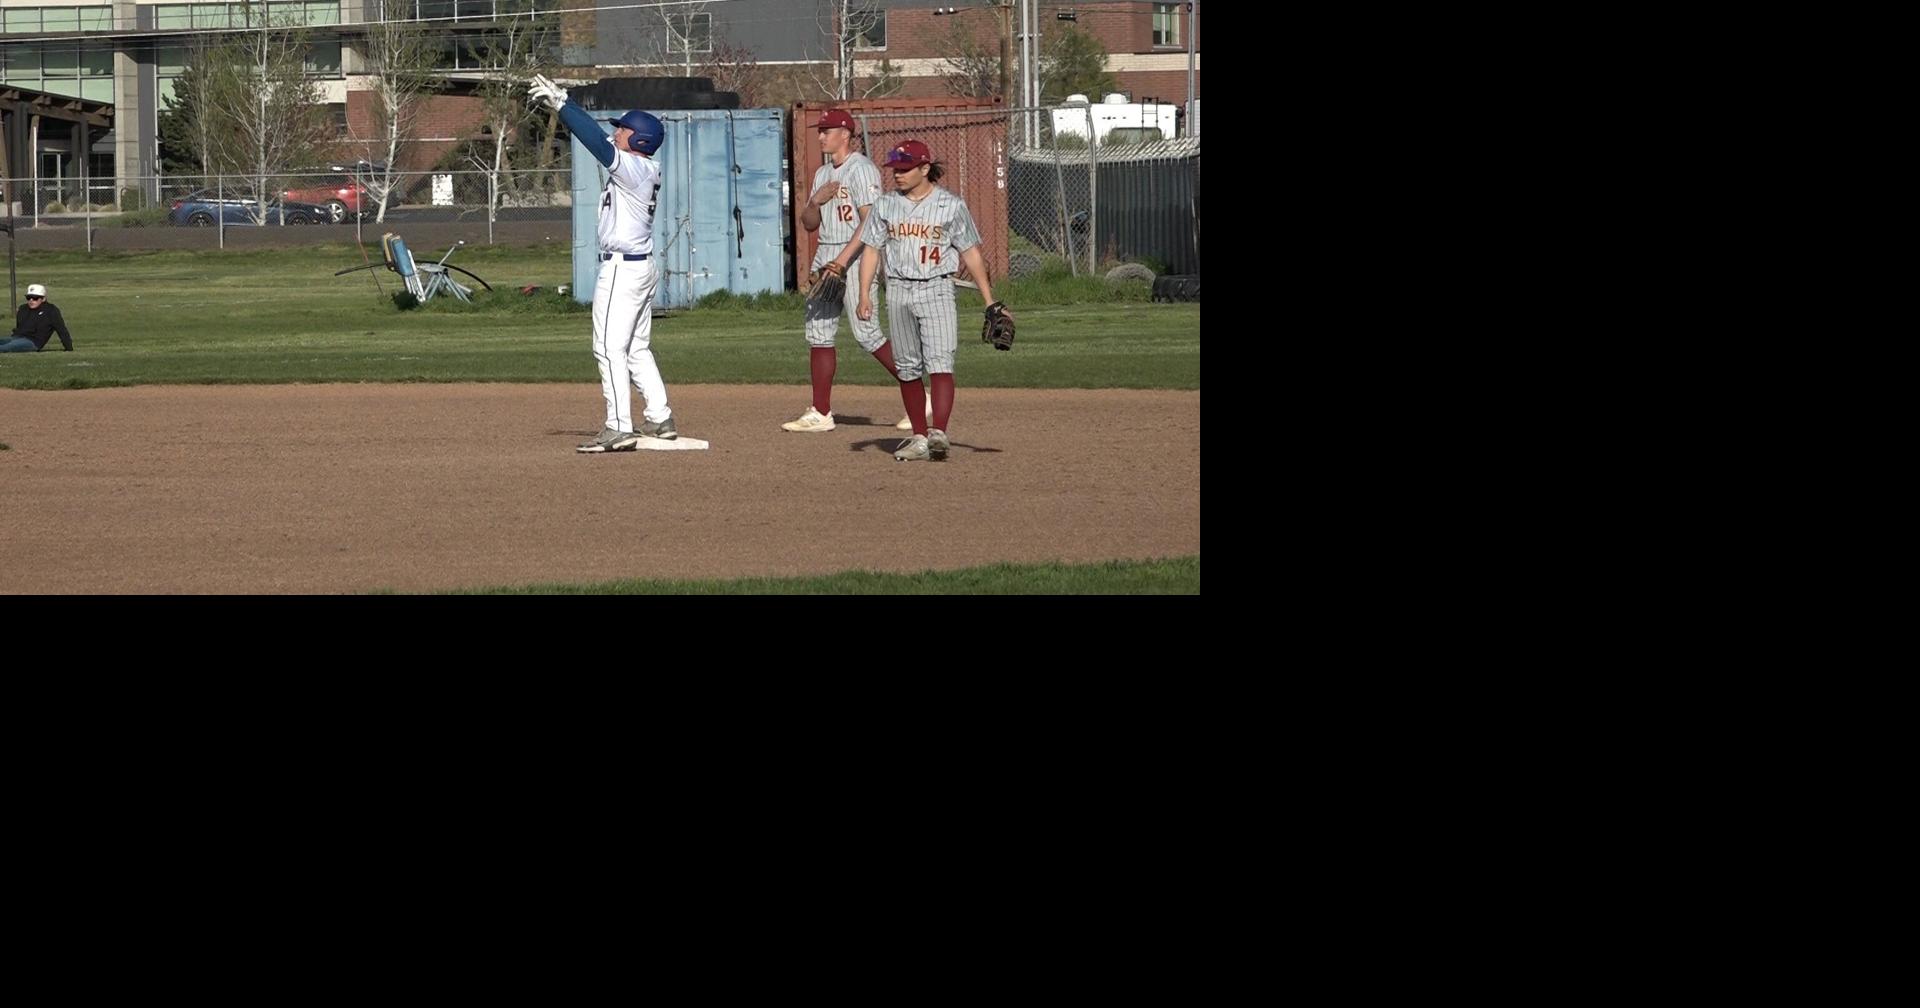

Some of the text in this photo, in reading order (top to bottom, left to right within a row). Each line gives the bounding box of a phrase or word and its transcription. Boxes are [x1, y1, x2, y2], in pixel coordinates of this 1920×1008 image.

[837, 204, 853, 222] 12
[886, 223, 943, 240] HAWKS
[919, 245, 941, 265] 14
